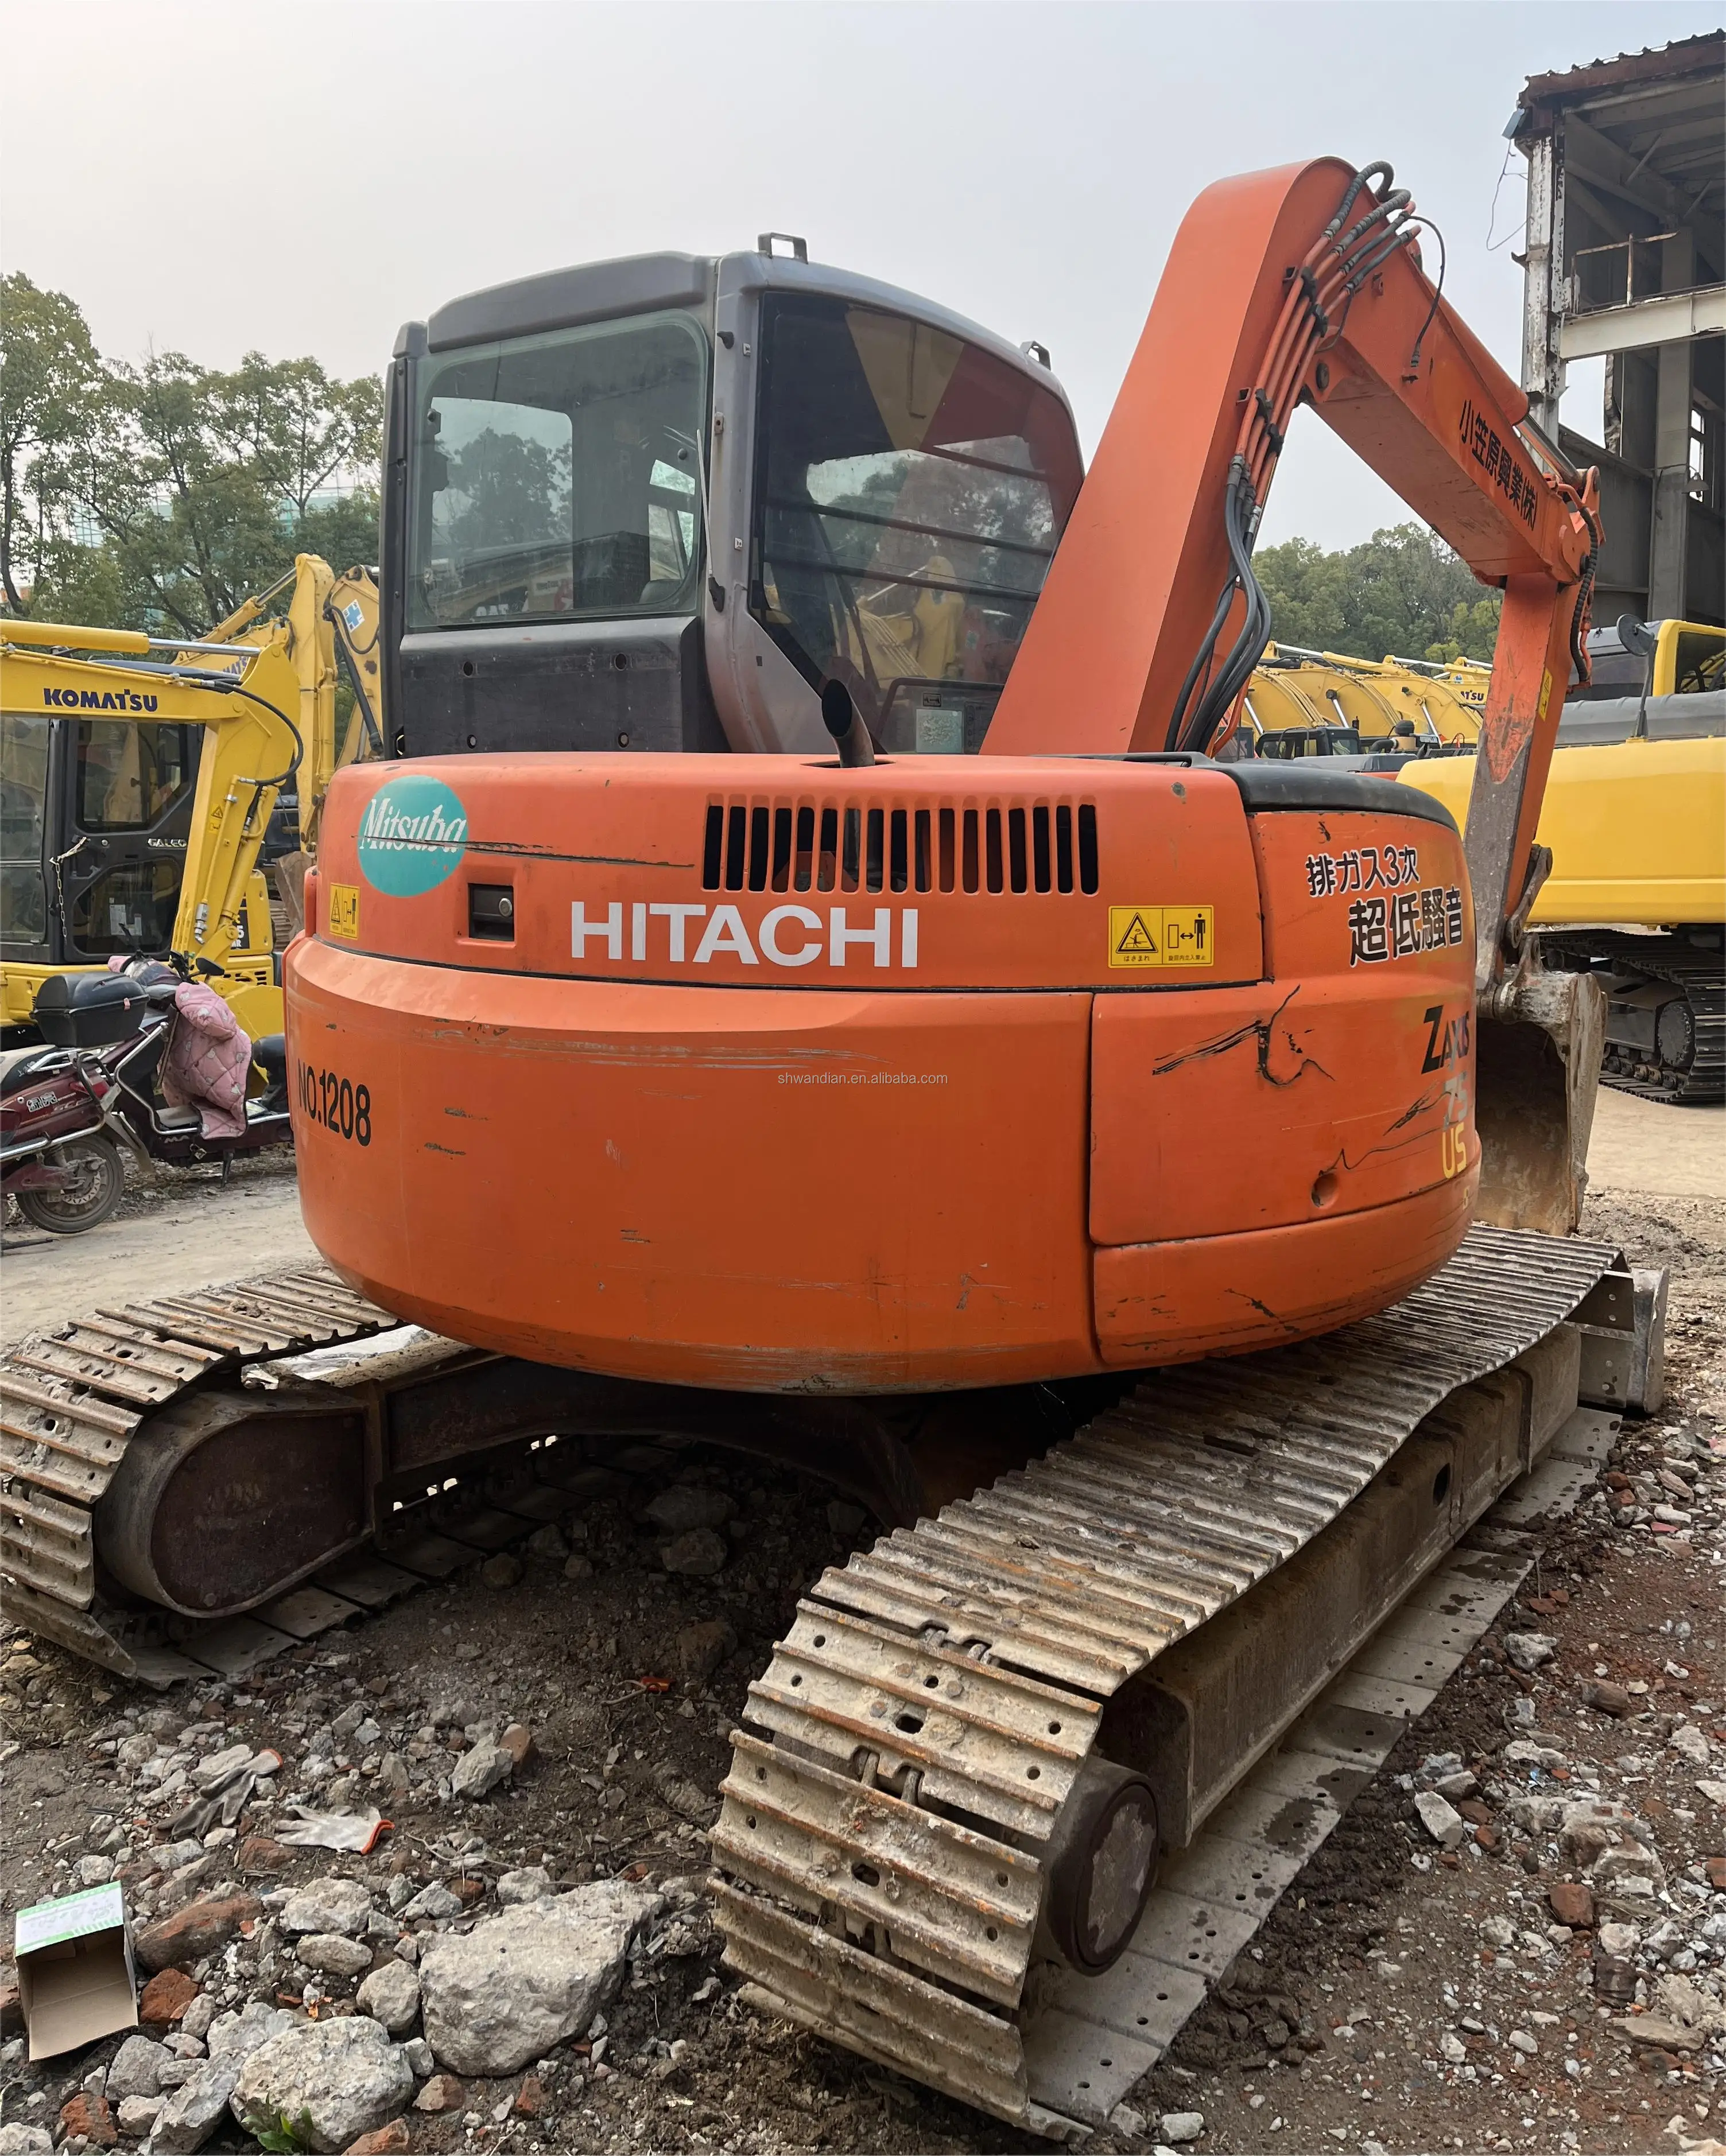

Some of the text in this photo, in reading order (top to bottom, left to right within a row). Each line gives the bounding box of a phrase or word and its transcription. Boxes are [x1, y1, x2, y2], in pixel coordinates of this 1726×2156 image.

[44, 688, 158, 712] KOMATSU
[148, 838, 187, 847] GALEO
[359, 798, 467, 853] Mitsuba
[1305, 845, 1420, 896] 排ガス3次
[571, 901, 918, 968] HITACHI
[1348, 884, 1463, 967] 超低騒音
[297, 1058, 371, 1147] NO.1208
[1442, 1122, 1467, 1179] US
